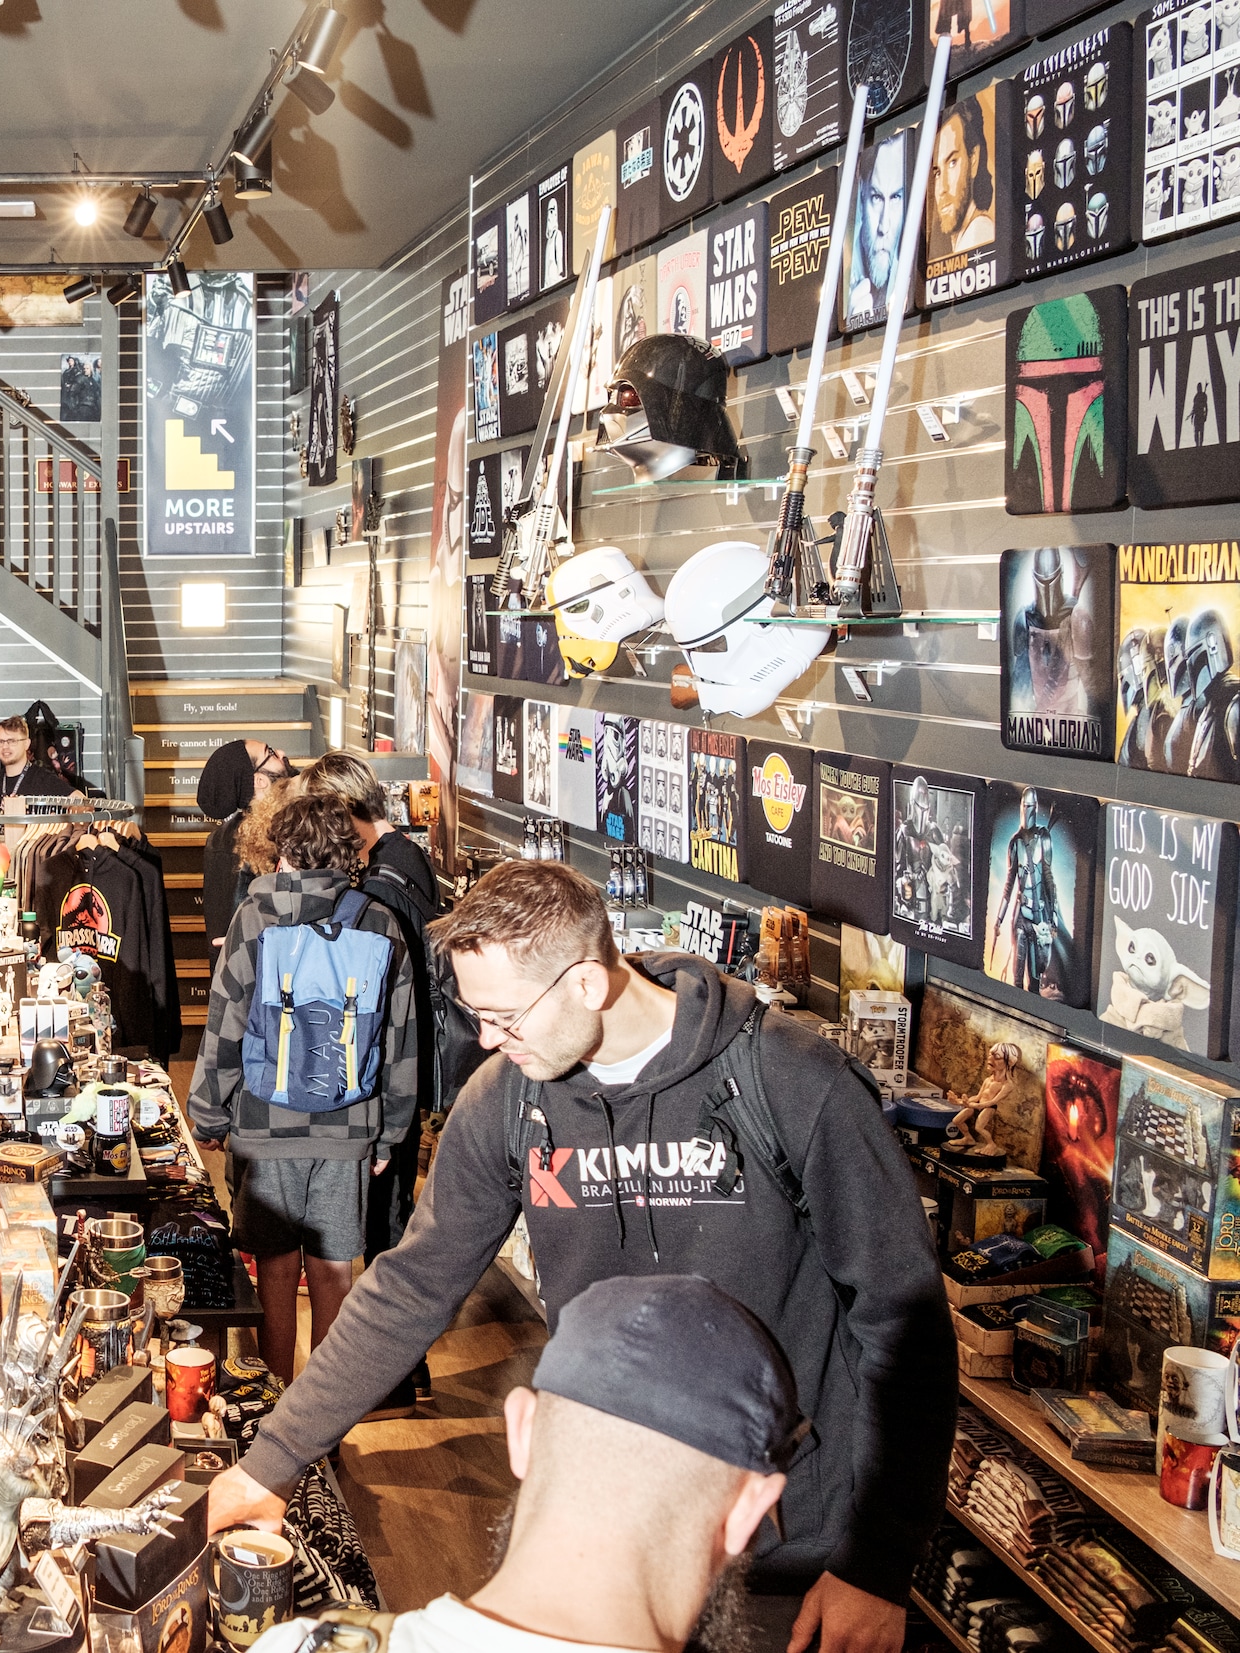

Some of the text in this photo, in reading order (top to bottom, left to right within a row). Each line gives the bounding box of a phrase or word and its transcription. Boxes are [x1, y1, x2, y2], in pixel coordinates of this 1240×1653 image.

[770, 193, 831, 248] PEW
[712, 217, 757, 277] STAR
[770, 236, 831, 286] PEW
[926, 253, 969, 278] OBI-WAN
[925, 259, 997, 306] KENOBI
[709, 269, 758, 329] WARS
[1137, 276, 1240, 342] THIS IS TH
[720, 329, 741, 349] 1977
[1137, 325, 1240, 456] WAY
[478, 405, 498, 426] STAR
[164, 498, 235, 518] MORE
[164, 521, 235, 536] UPSTAIRS
[1119, 541, 1240, 583] MANDALORIAN
[183, 702, 238, 715] Fly, you fools!
[161, 738, 223, 748] Fire cannot kill
[1007, 717, 1102, 754] MANDALORIAN
[169, 776, 181, 785] To
[752, 765, 807, 813] Mos Eisley
[170, 814, 186, 824] I'm
[187, 814, 201, 823] the
[770, 805, 785, 819] CAFE
[764, 831, 793, 850] TATOOINE
[1111, 805, 1217, 872] THIS IS MY
[690, 839, 740, 884] CANTINA
[1108, 856, 1212, 930] GOOD SIDE
[680, 900, 725, 941] STAR
[679, 920, 723, 964] WARS
[190, 986, 206, 996] I'm
[893, 1006, 908, 1071] STORMTROOPER
[3, 1163, 27, 1180] RINGS
[649, 1197, 692, 1207] NORWAY
[1192, 1221, 1201, 1233] 32
[1215, 1212, 1236, 1253] LORD
[243, 1569, 279, 1581] One Ring
[247, 1578, 265, 1588] One
[151, 1565, 200, 1627] LORD RINGS
[251, 1594, 264, 1603] and
[252, 1586, 270, 1597] One
